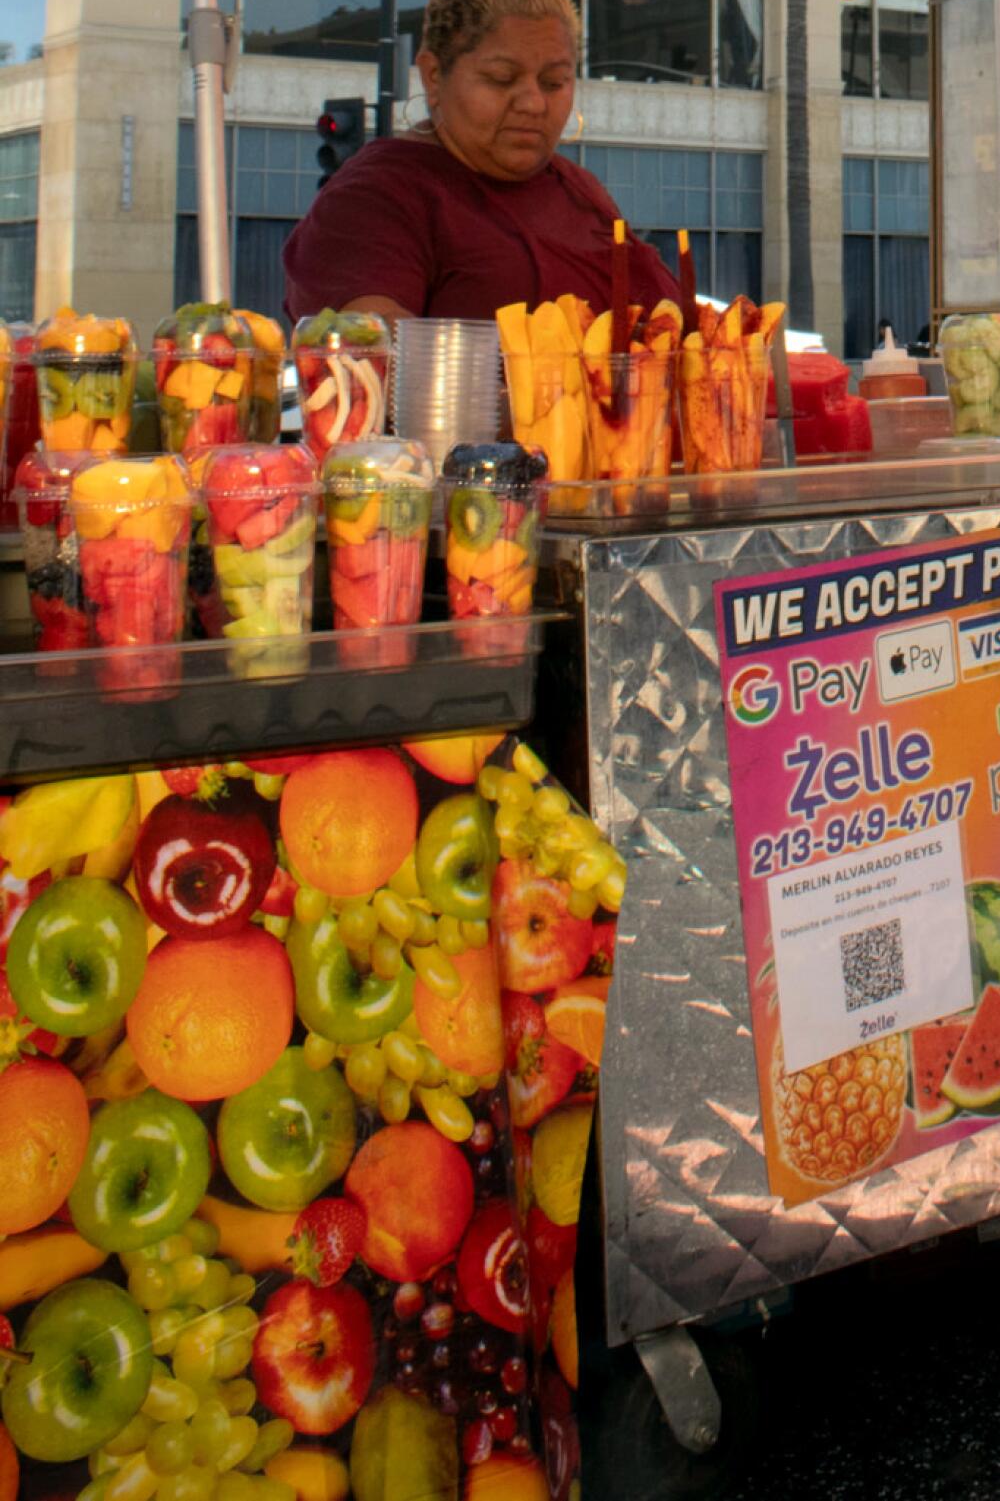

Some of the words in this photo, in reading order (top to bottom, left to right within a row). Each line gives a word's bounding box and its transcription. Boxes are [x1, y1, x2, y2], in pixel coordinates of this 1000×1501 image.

[733, 587, 804, 646] WE
[814, 554, 973, 631] ACCEPT
[791, 661, 869, 712] Pay
[909, 645, 943, 669] Pay
[786, 724, 931, 822] Zelle
[752, 780, 972, 876] 213-949-4707
[781, 873, 831, 899] MERLIN
[834, 852, 901, 884] ALVARADO
[904, 840, 943, 862] REYES
[860, 1013, 896, 1039] Zelle
